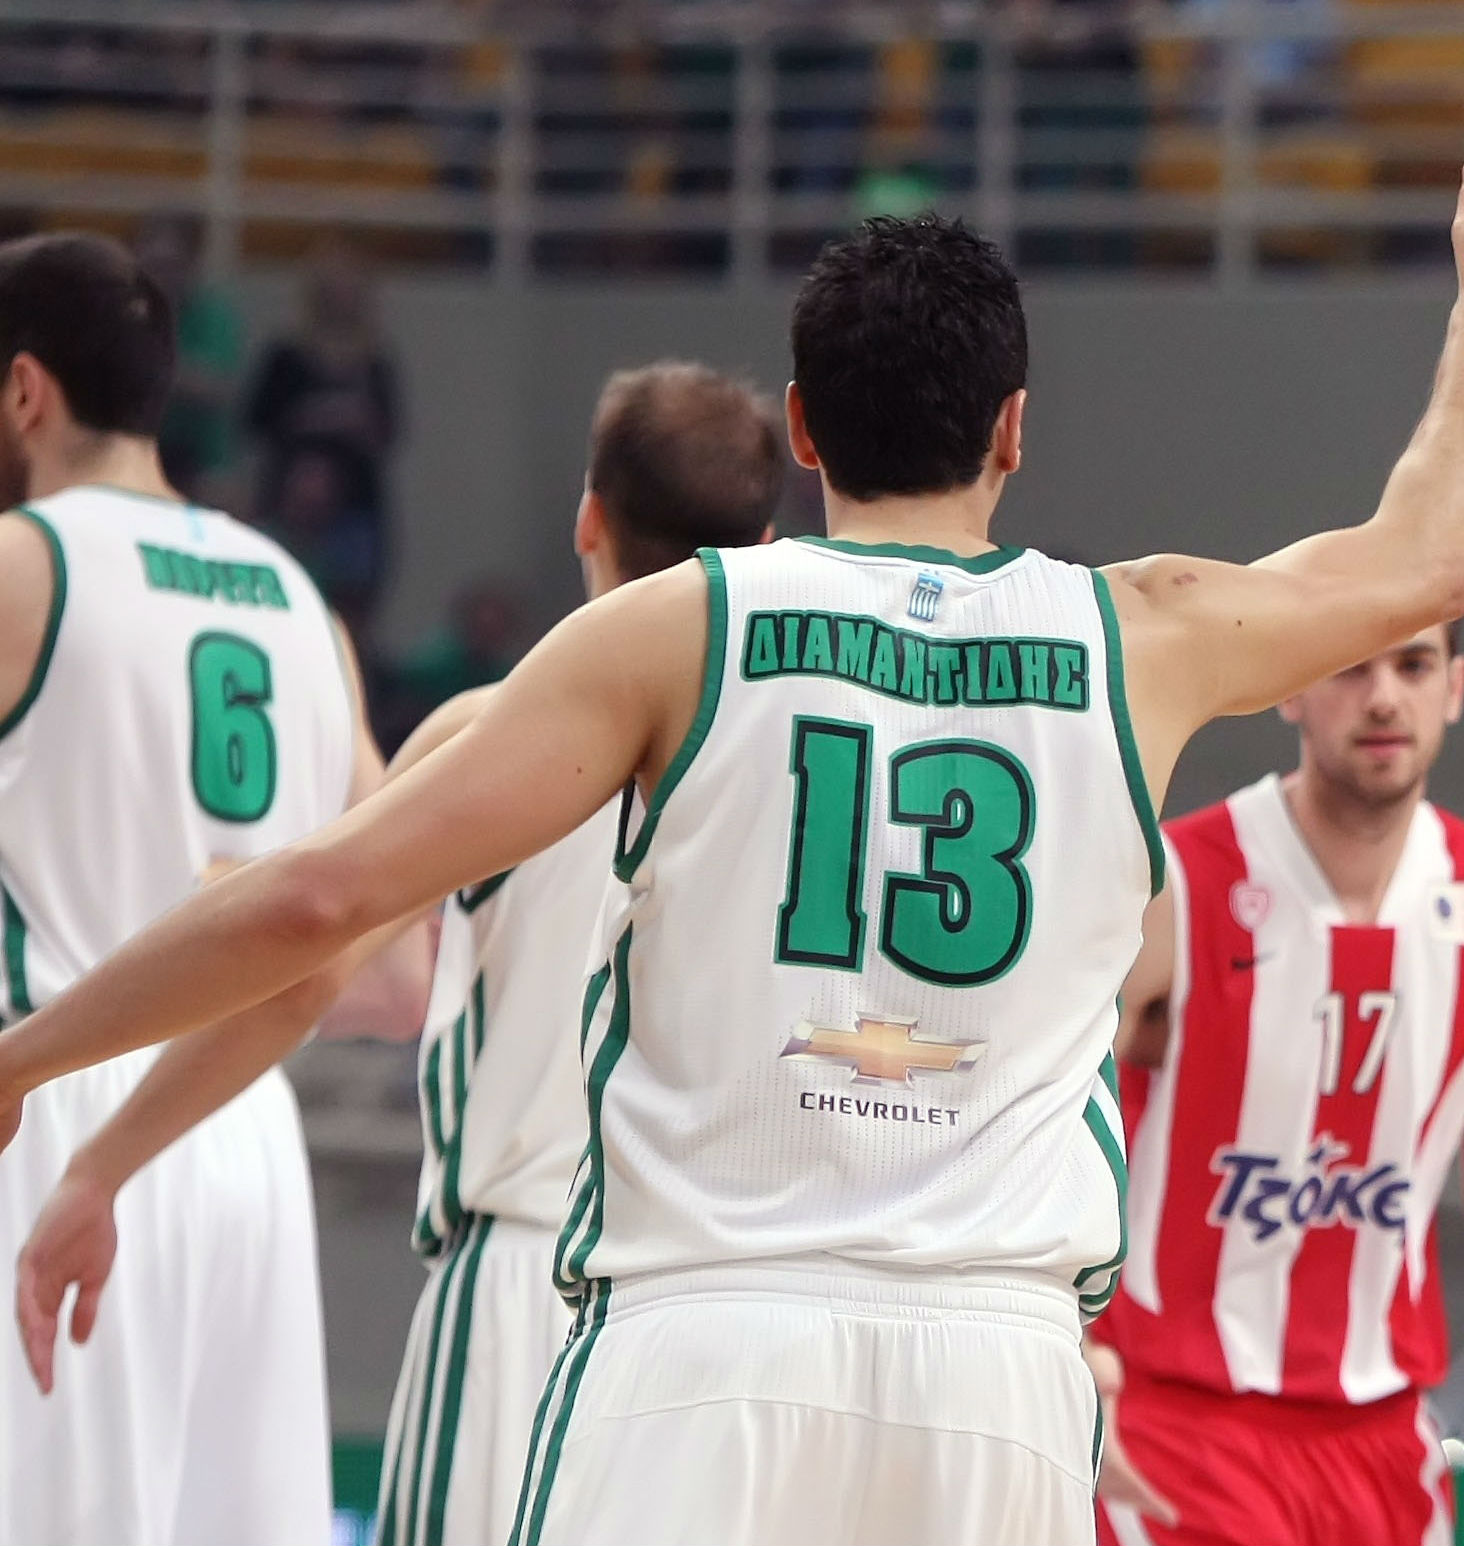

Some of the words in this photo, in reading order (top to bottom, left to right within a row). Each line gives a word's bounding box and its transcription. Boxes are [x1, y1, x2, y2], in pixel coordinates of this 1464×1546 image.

[740, 609, 1090, 712] ΔΙΑΜΑΝΤΙΔΗΣ
[188, 629, 277, 823] 6
[774, 714, 1036, 988] 13
[1313, 990, 1401, 1095] 17
[800, 1091, 960, 1127] CHEVROLET
[1218, 1147, 1410, 1243] Τζόκε
